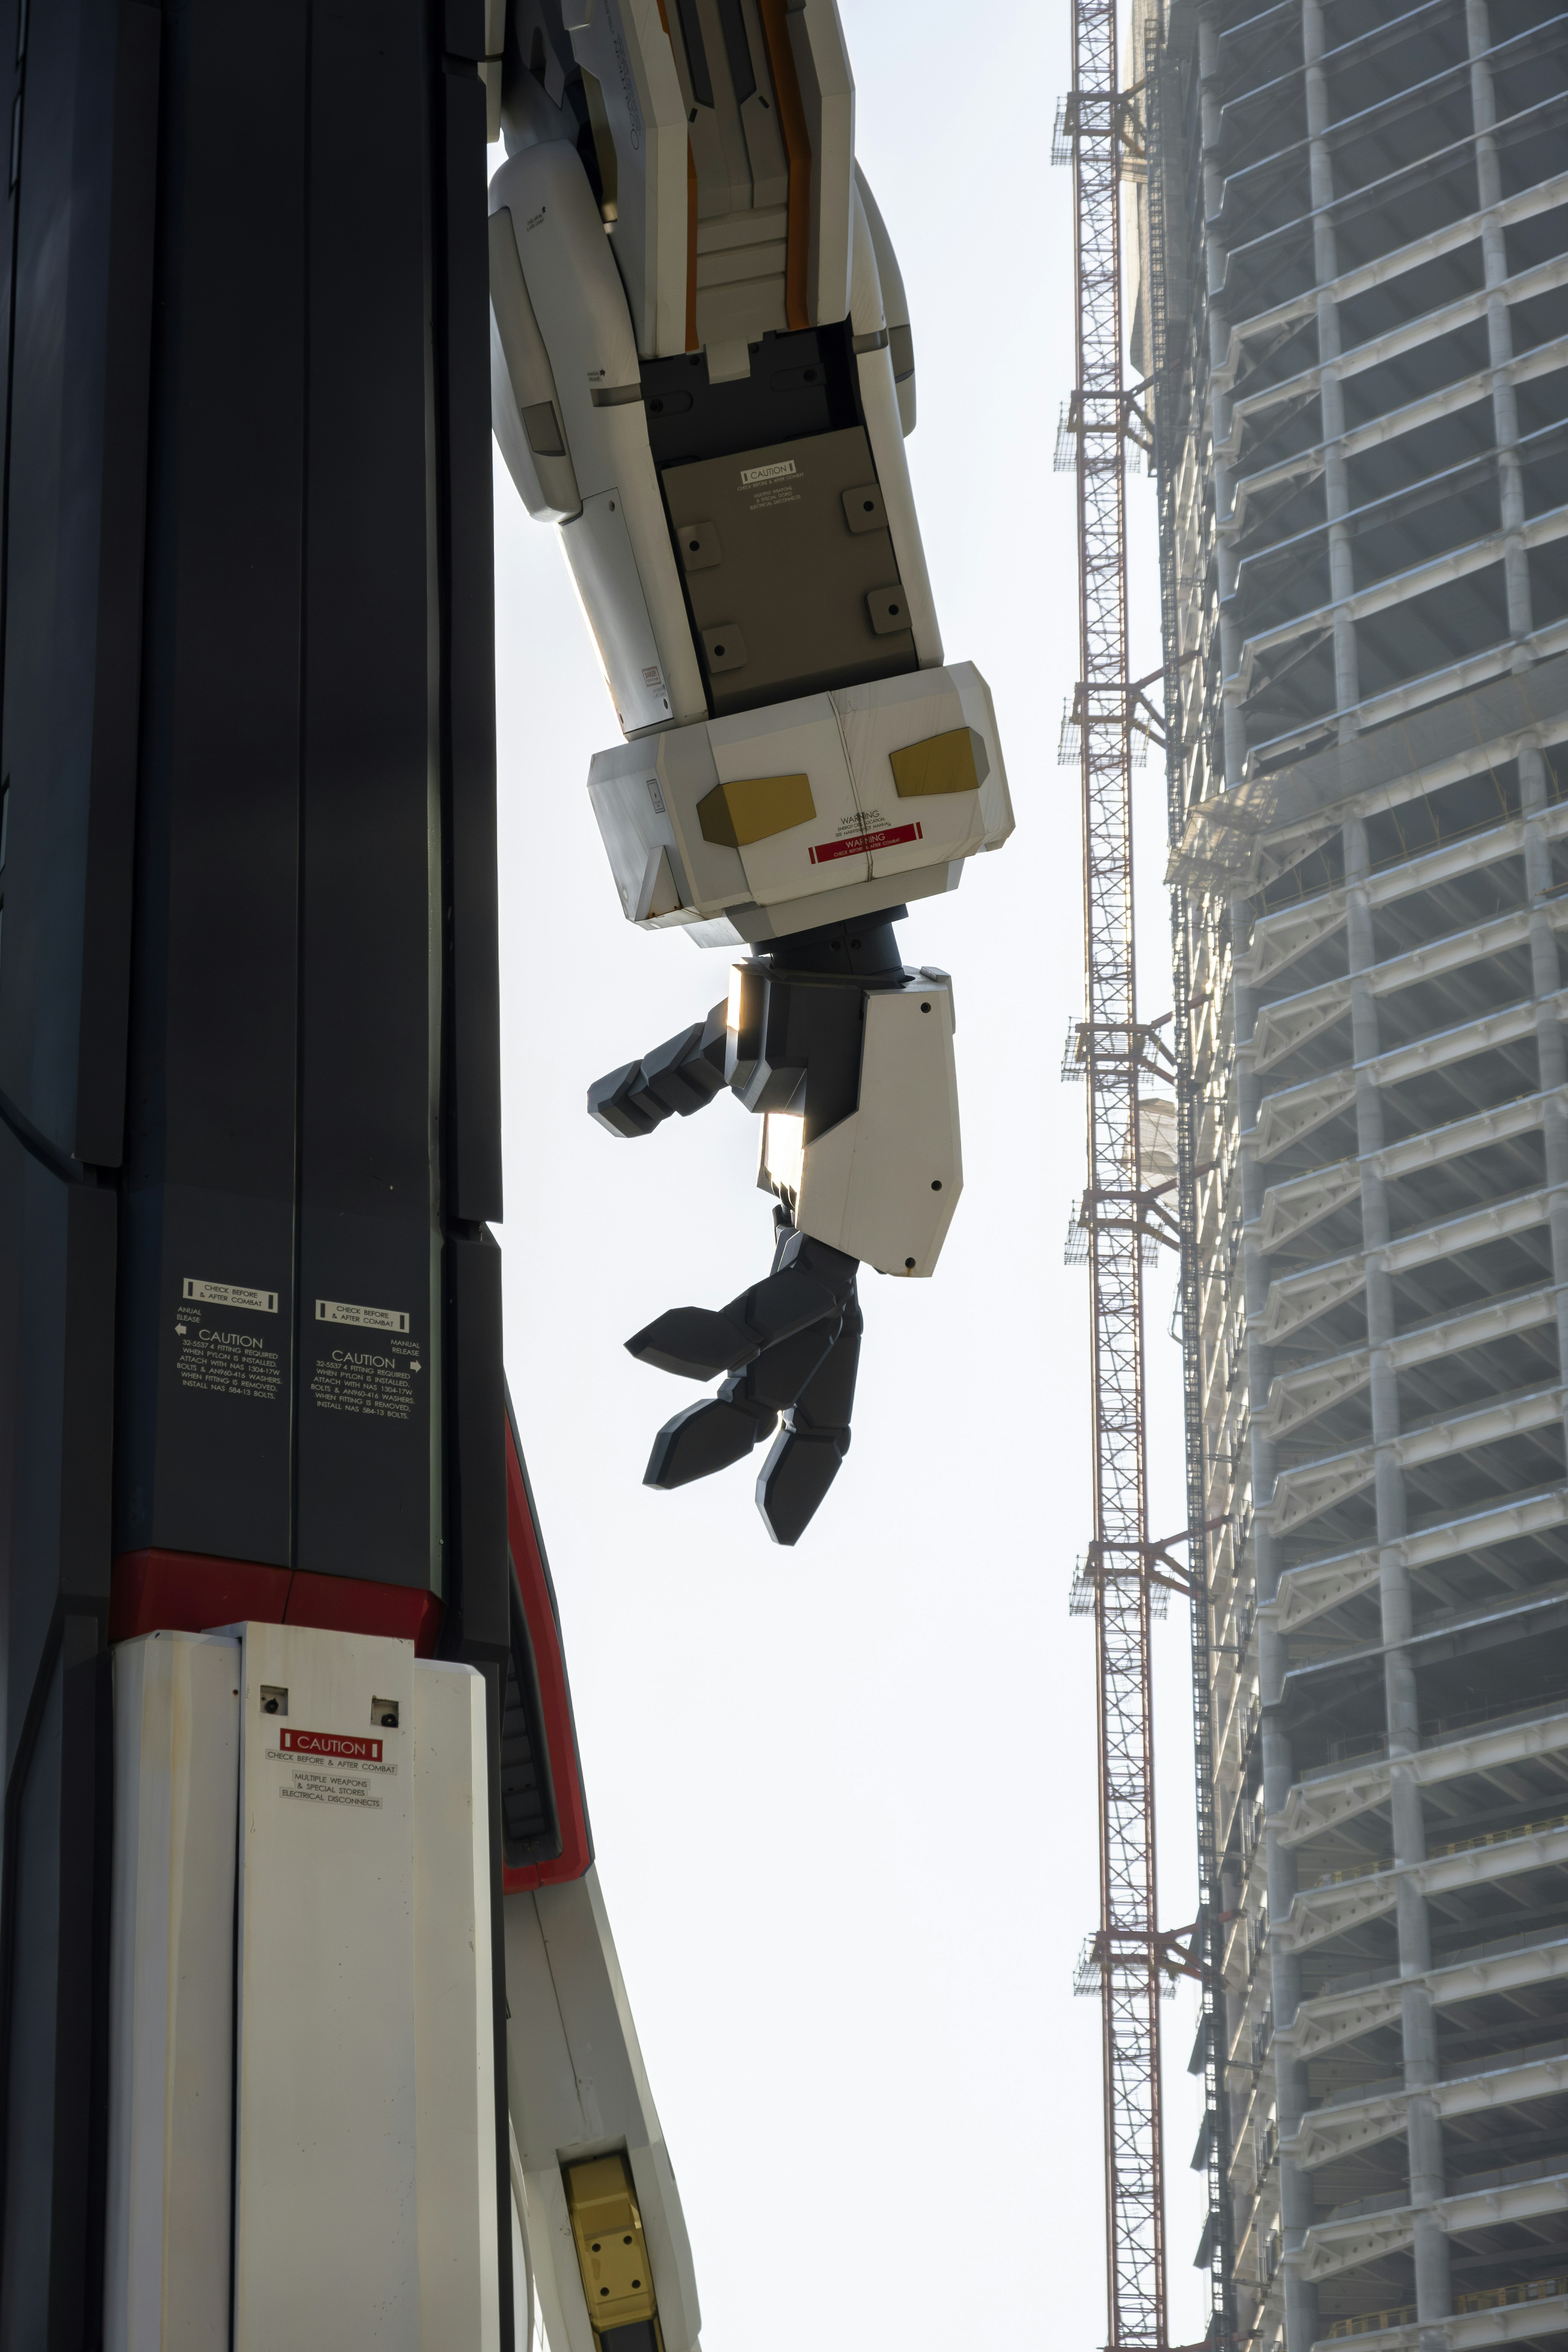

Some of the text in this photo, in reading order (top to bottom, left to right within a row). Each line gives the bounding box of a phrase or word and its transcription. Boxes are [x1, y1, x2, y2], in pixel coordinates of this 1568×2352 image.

[751, 465, 786, 479] CAUTION
[204, 1285, 257, 1298] CHECK BEFORE
[231, 1297, 262, 1306] COMBAT
[363, 1318, 394, 1327] COMBAT
[199, 1330, 262, 1348] CAUTION
[390, 1340, 420, 1348] MANUAL
[217, 1345, 241, 1353] FITTING
[245, 1349, 278, 1359] REQUIRED
[392, 1347, 419, 1356] RELEASE
[179, 1355, 207, 1364] ATTACH
[248, 1366, 280, 1375] 1304-17W
[207, 1351, 230, 1360] PYLON
[242, 1357, 277, 1367] INSTALLED.
[332, 1351, 395, 1369] CAUTION
[205, 1375, 229, 1384] FITTING
[209, 1368, 245, 1378] AN960-416
[249, 1374, 282, 1384] WASHERS.
[377, 1369, 410, 1379] REQUIRED
[314, 1376, 340, 1385] ATTACH
[381, 1386, 412, 1395] 1304-17W
[375, 1377, 409, 1387] INSTALLED.
[182, 1380, 207, 1389] INSTALL
[228, 1387, 250, 1395] 584-13
[254, 1391, 275, 1399] BOLTS.
[343, 1388, 378, 1399] AN960-416
[382, 1394, 415, 1404] WASHERS.
[317, 1401, 341, 1409] INSTALL
[297, 1737, 364, 1755] CAUTION
[267, 1752, 293, 1761] CHECK
[297, 1756, 324, 1764] BEFORE
[337, 1760, 358, 1769] AFTER
[362, 1763, 394, 1773] COMBAT
[294, 1774, 367, 1787] MULTIPLE WEAPONS
[306, 1784, 335, 1793] SPECIAL
[282, 1790, 379, 1807] ELECTRICAL DISCONNECTS
